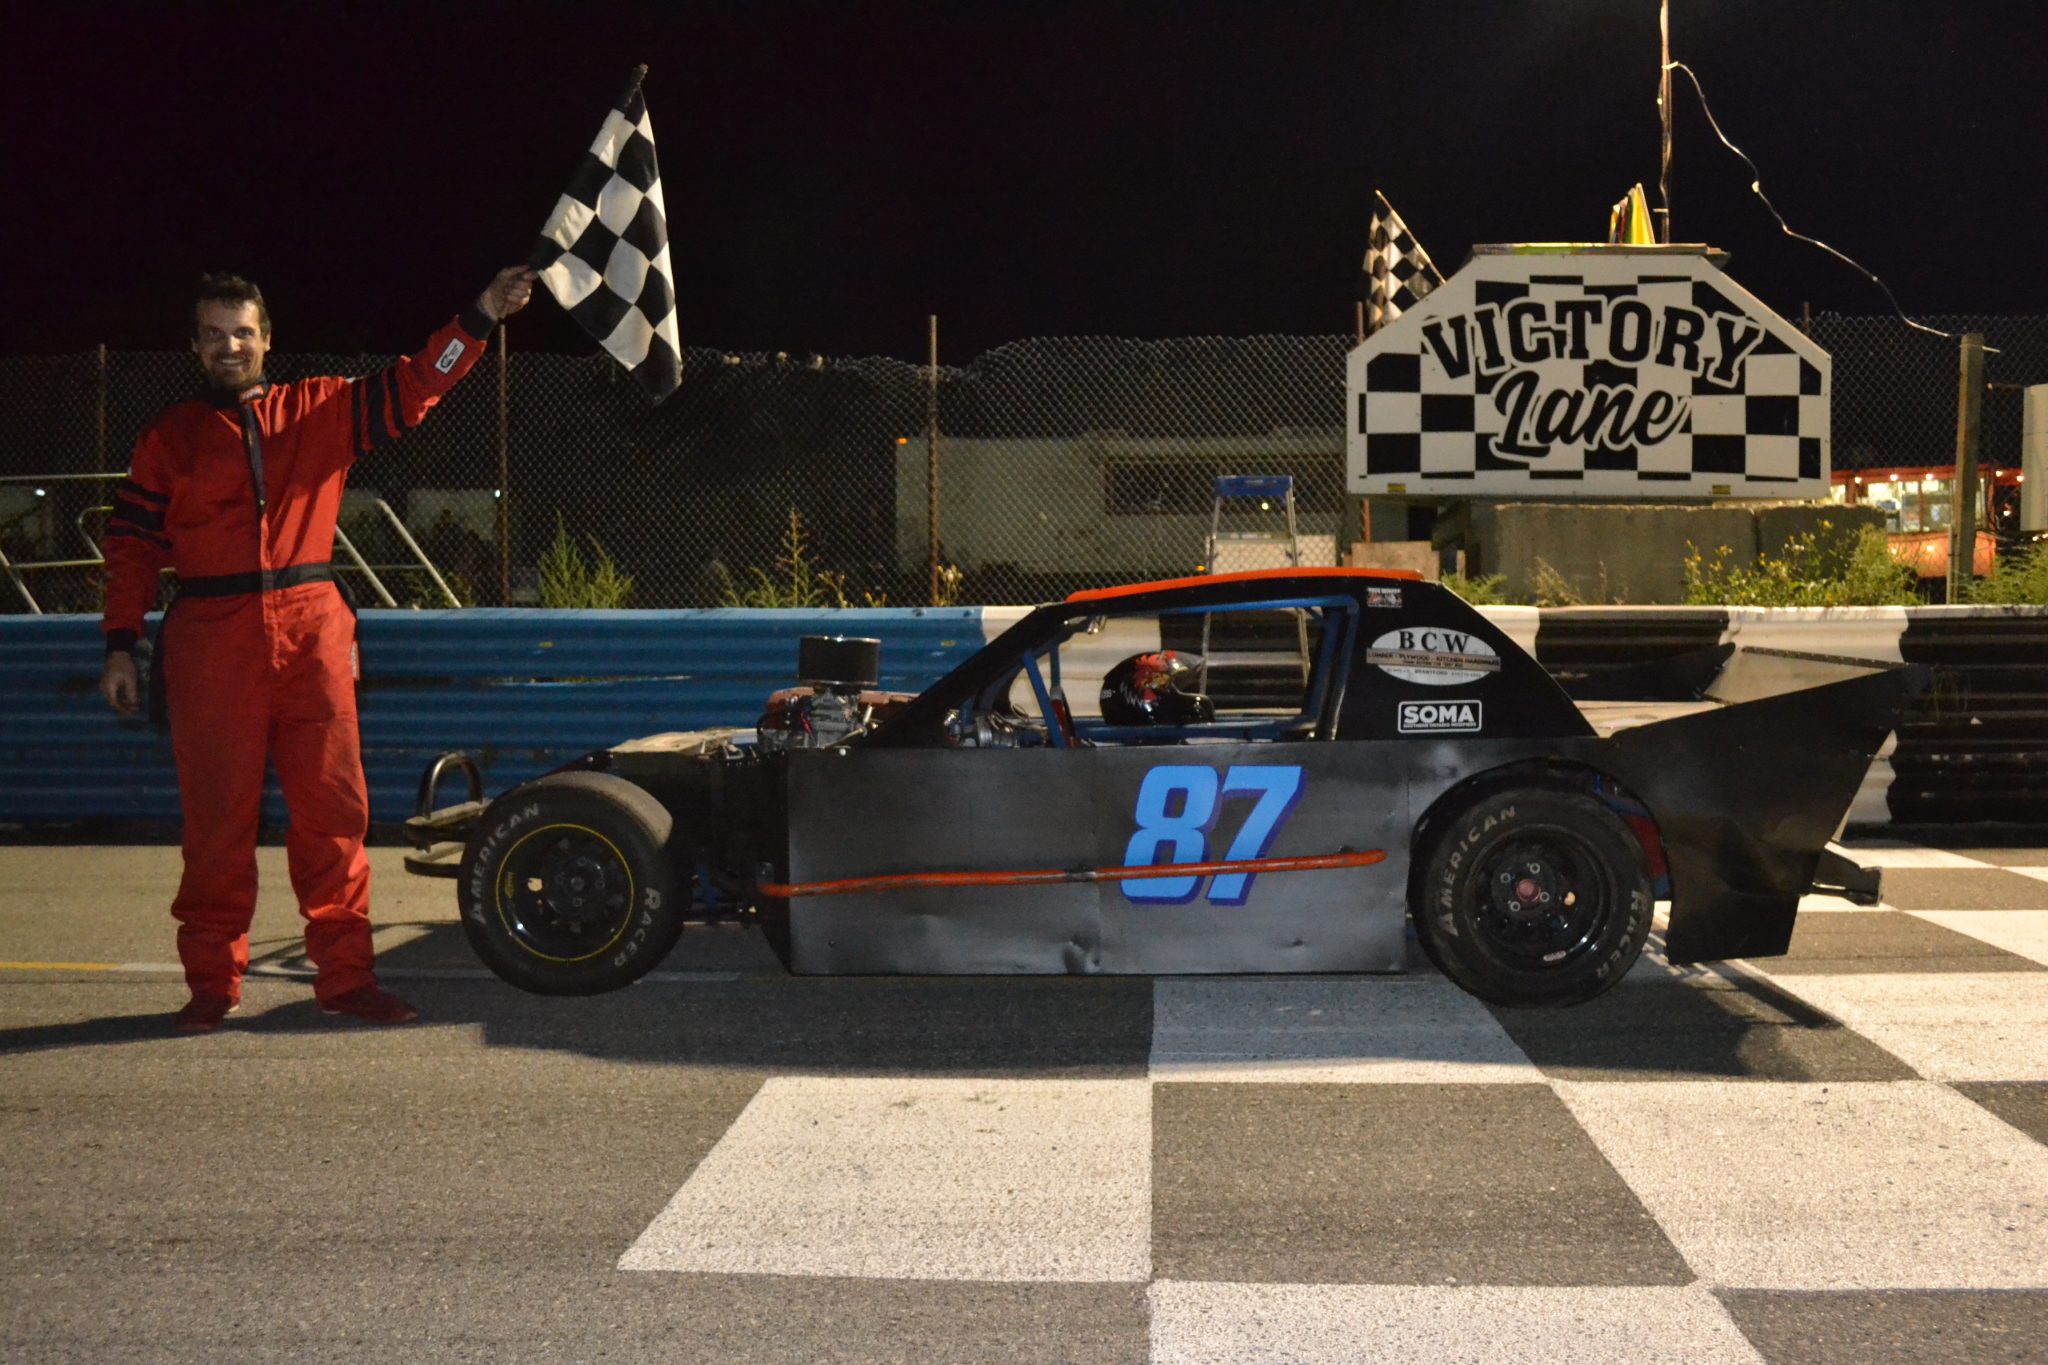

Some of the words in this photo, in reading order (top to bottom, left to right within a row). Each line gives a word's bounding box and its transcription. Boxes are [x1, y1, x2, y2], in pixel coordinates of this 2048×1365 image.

[1421, 300, 1760, 382] VICTORY
[1494, 370, 1690, 458] Lane
[1399, 631, 1470, 653] BCW
[1404, 705, 1475, 724] SOMA
[1119, 764, 1308, 907] 87
[471, 802, 540, 925] AMERICAN
[613, 887, 661, 967] RACER
[1438, 805, 1517, 937] AMERICAN
[1596, 889, 1648, 978] RACER
